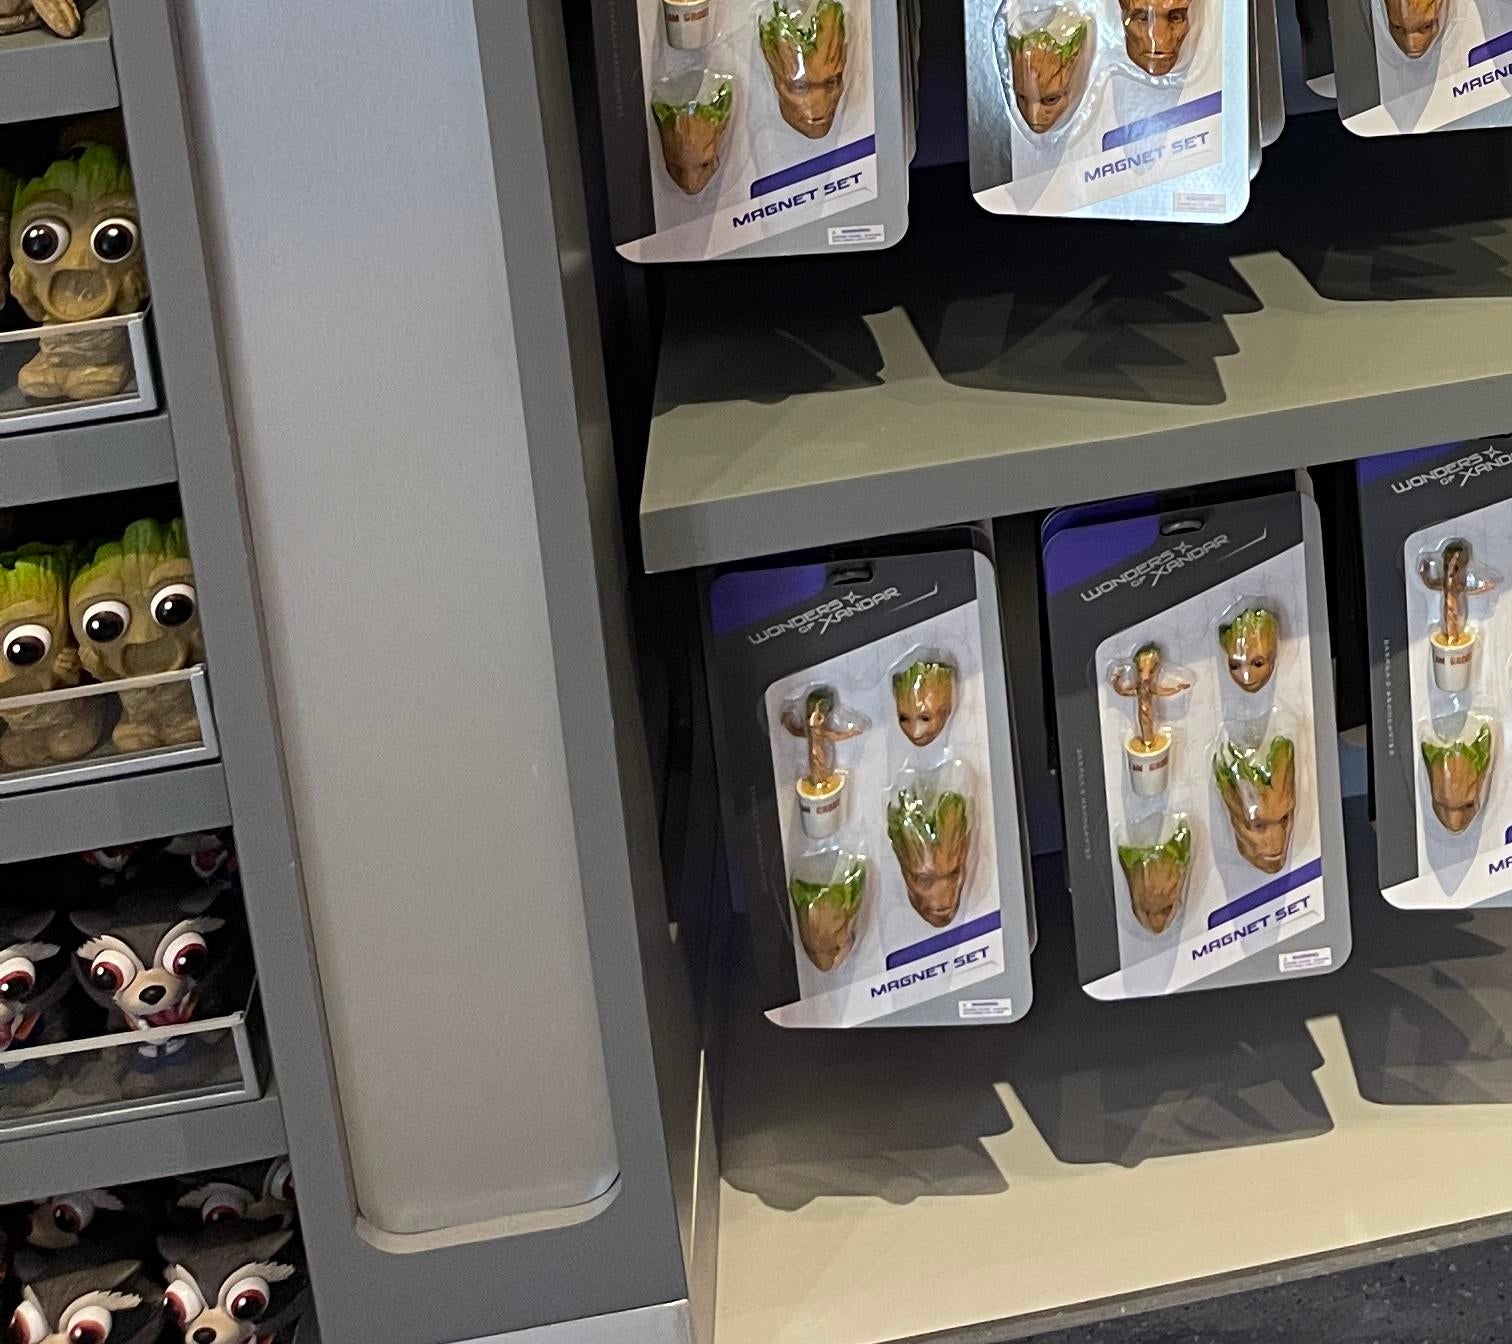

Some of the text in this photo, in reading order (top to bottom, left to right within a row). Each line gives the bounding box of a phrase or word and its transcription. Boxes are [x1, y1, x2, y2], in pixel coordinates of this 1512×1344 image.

[1084, 132, 1209, 183] MAGNET SET
[732, 172, 863, 228] MAGNET SET
[1391, 453, 1483, 494] WONDERS
[1080, 549, 1174, 602] WONDERS
[1151, 534, 1230, 587] XANDAR
[748, 599, 843, 644] WONDERS
[819, 587, 901, 635] XANDAR
[1192, 914, 1270, 960] MAGNET
[1275, 896, 1310, 921] SET
[870, 946, 989, 998] MAGNET SET
